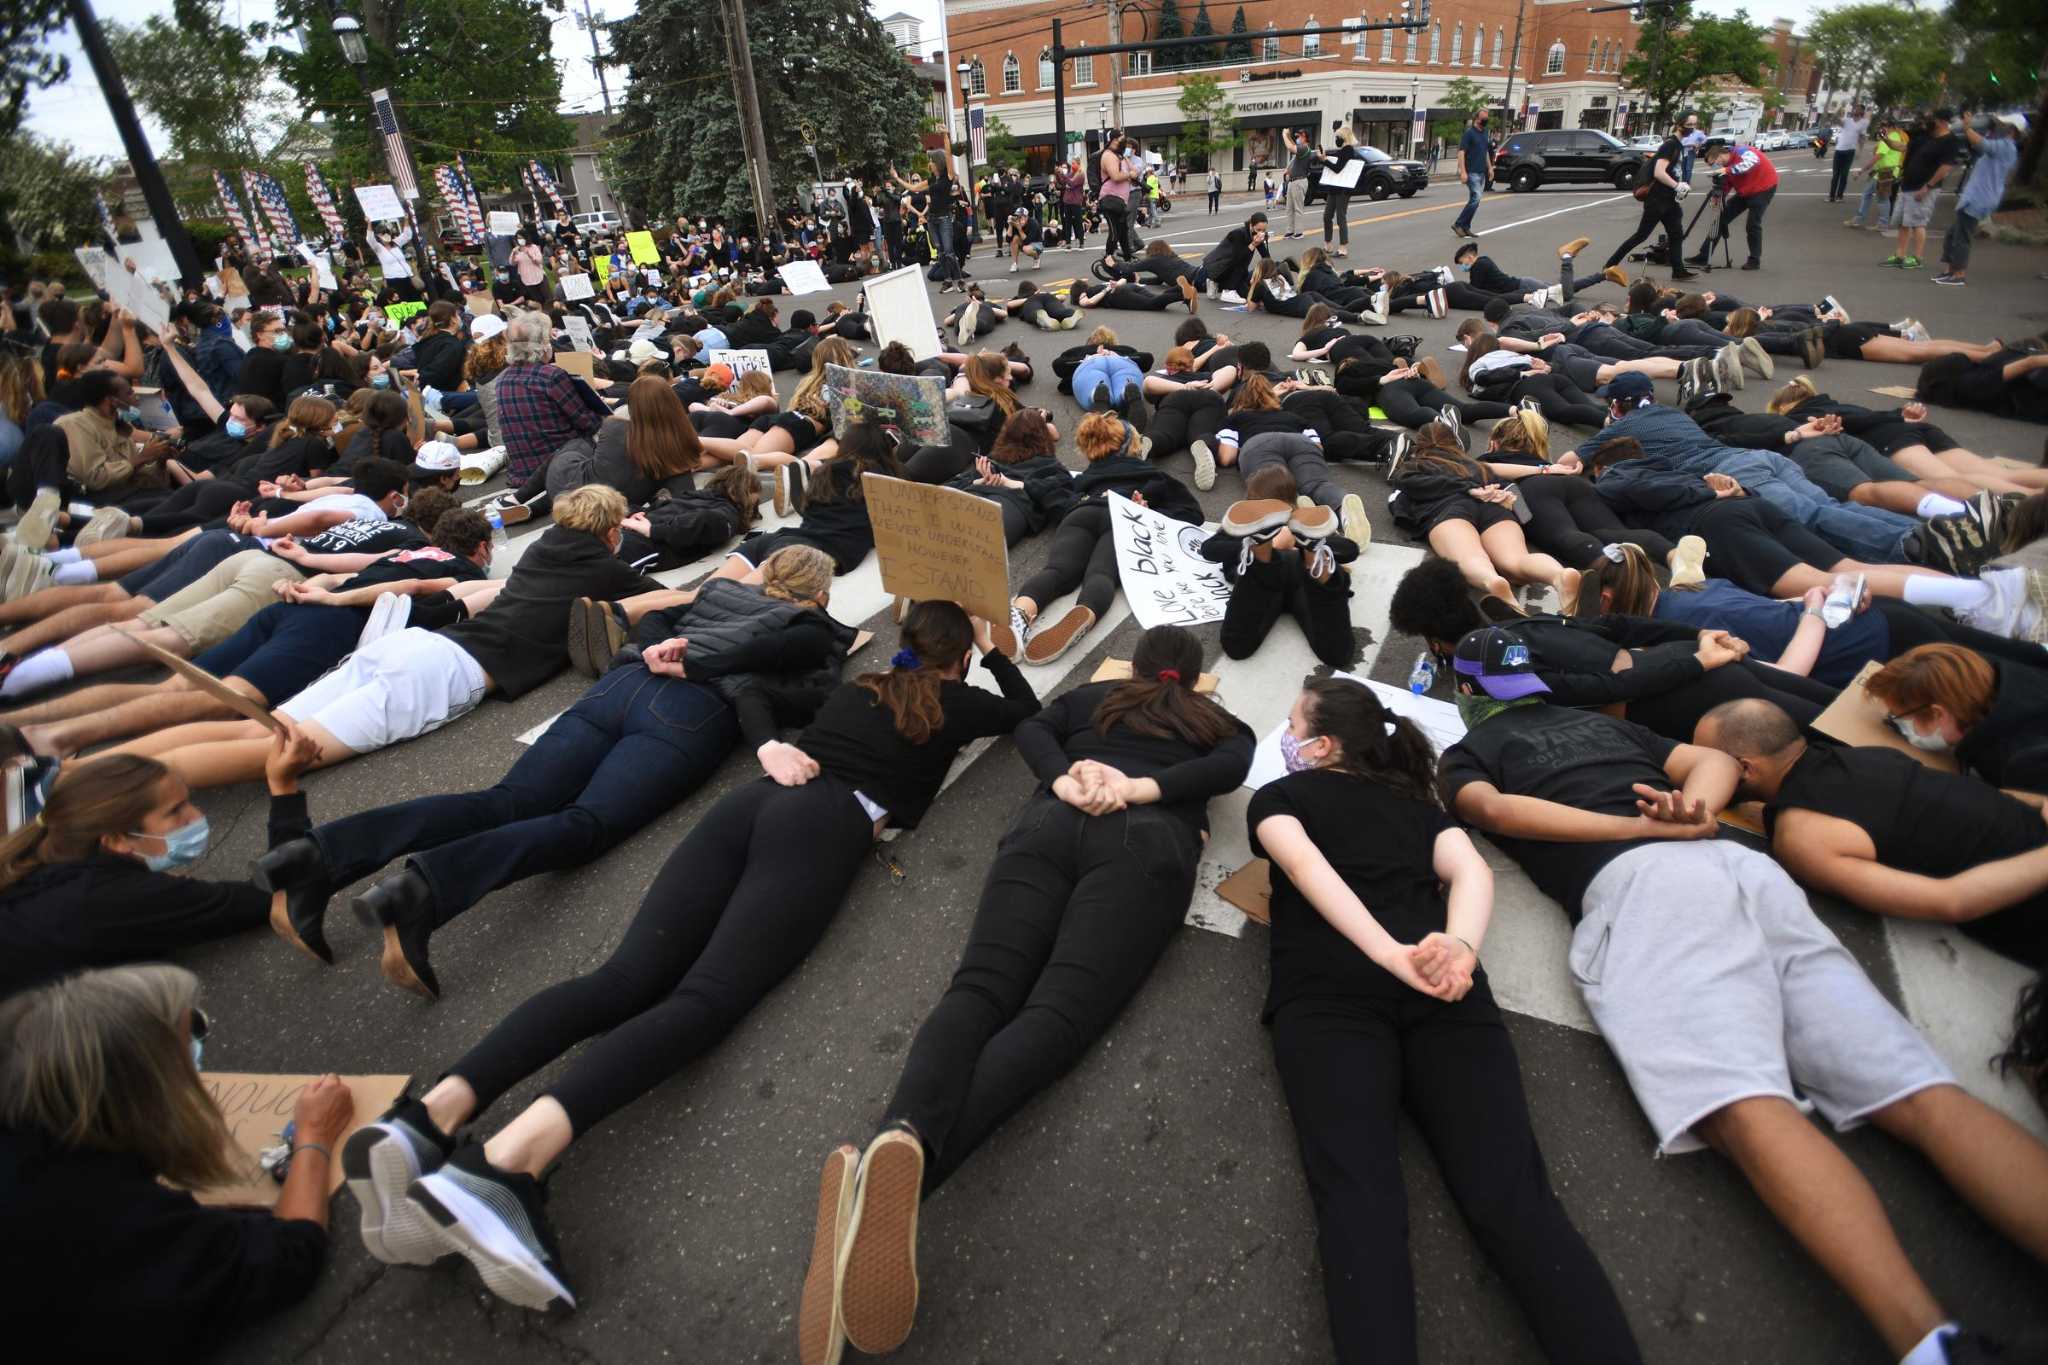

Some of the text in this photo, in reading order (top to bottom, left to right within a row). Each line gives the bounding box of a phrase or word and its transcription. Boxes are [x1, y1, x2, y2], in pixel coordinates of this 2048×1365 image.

[1238, 97, 1319, 112] VICTORIA'S SECRET
[1122, 506, 1159, 575] black
[906, 563, 985, 599] STAND
[1192, 572, 1233, 601] lack
[1510, 716, 1617, 753] VANS
